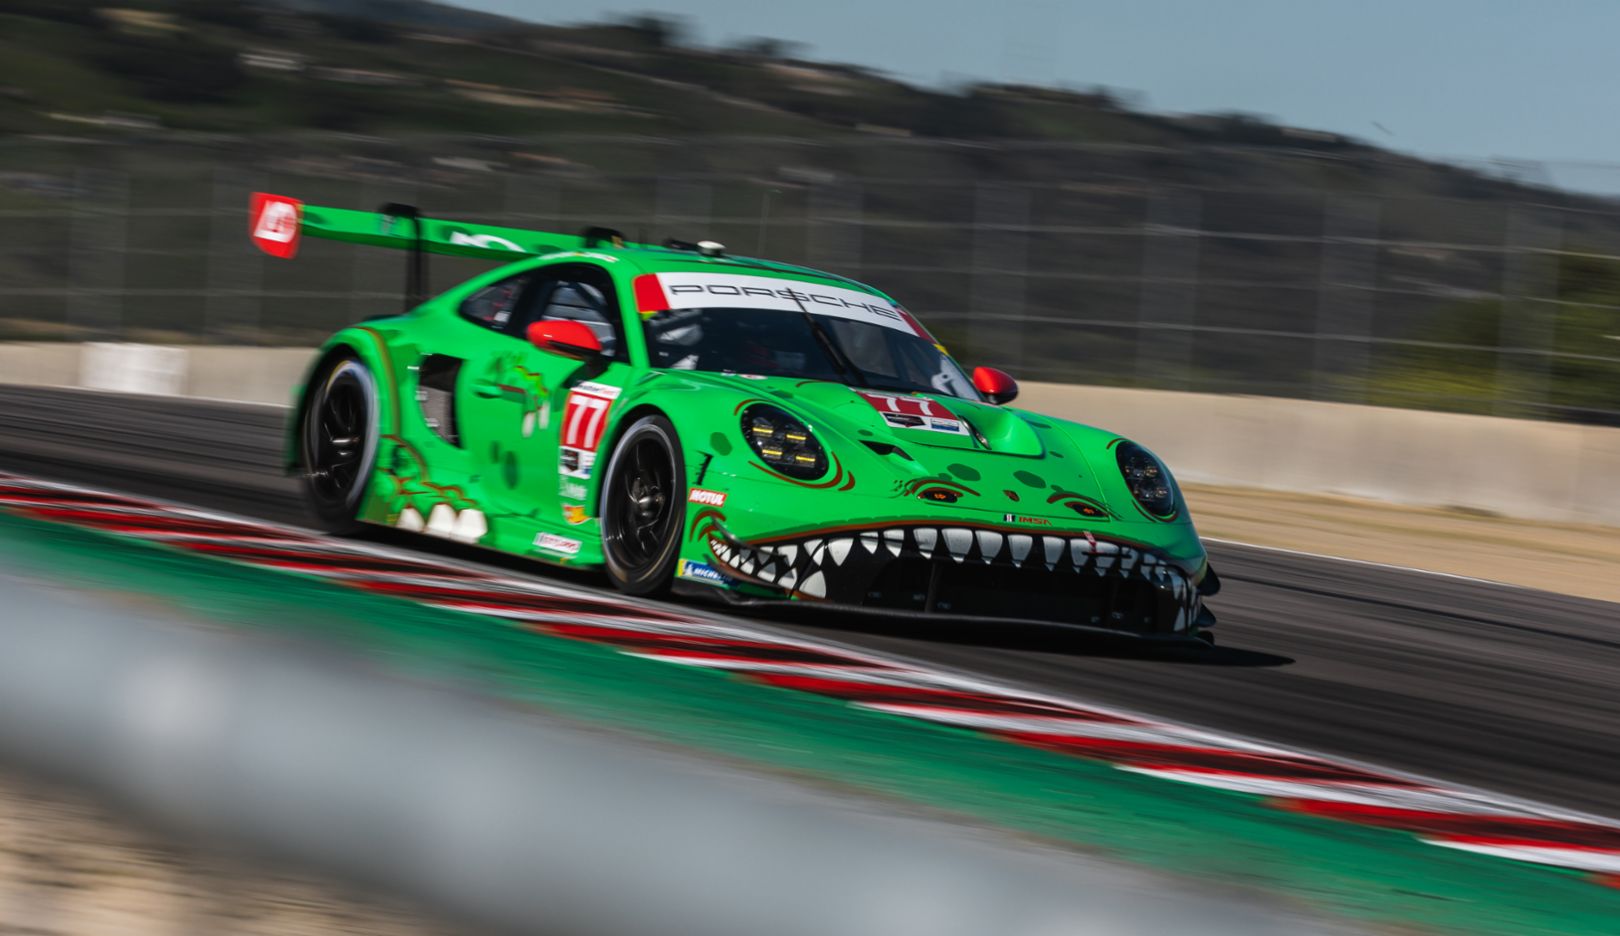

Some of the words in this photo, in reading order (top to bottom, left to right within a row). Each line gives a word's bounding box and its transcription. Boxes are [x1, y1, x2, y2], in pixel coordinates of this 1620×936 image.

[669, 284, 903, 322] PORSCHE
[865, 393, 933, 416] 77
[566, 394, 610, 449] 77
[690, 489, 726, 506] MOTUL
